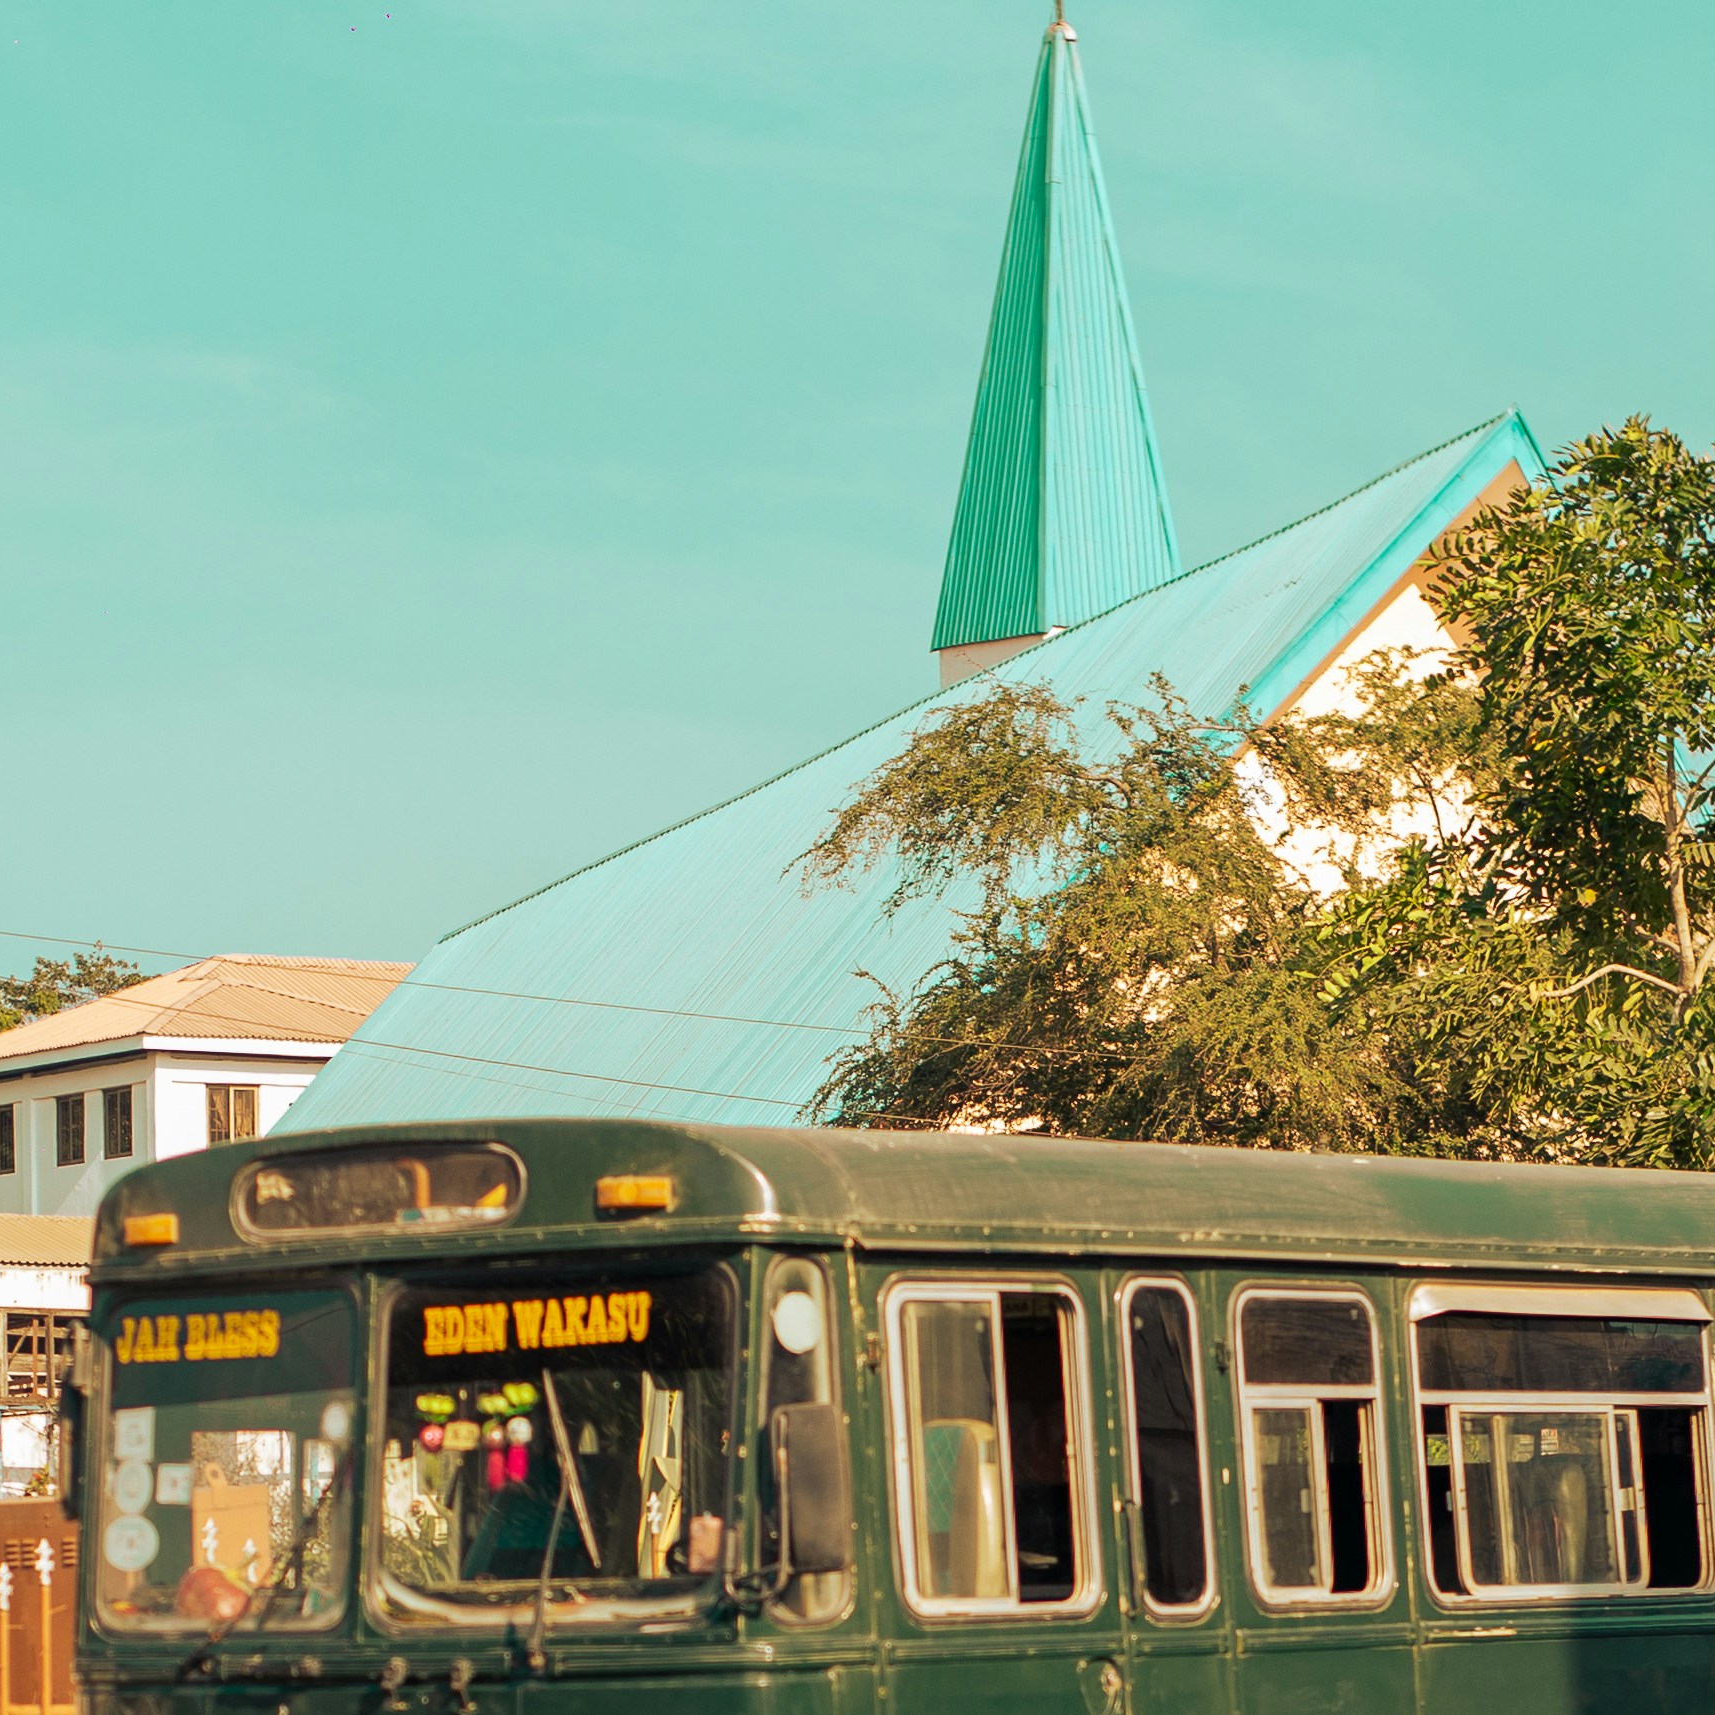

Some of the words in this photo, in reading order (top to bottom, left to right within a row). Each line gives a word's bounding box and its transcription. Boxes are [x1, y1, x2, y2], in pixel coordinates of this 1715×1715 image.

[115, 1315, 181, 1365] JAH
[183, 1308, 281, 1361] BLESS
[423, 1302, 509, 1357] EDEN
[512, 1290, 653, 1349] WAKASU
